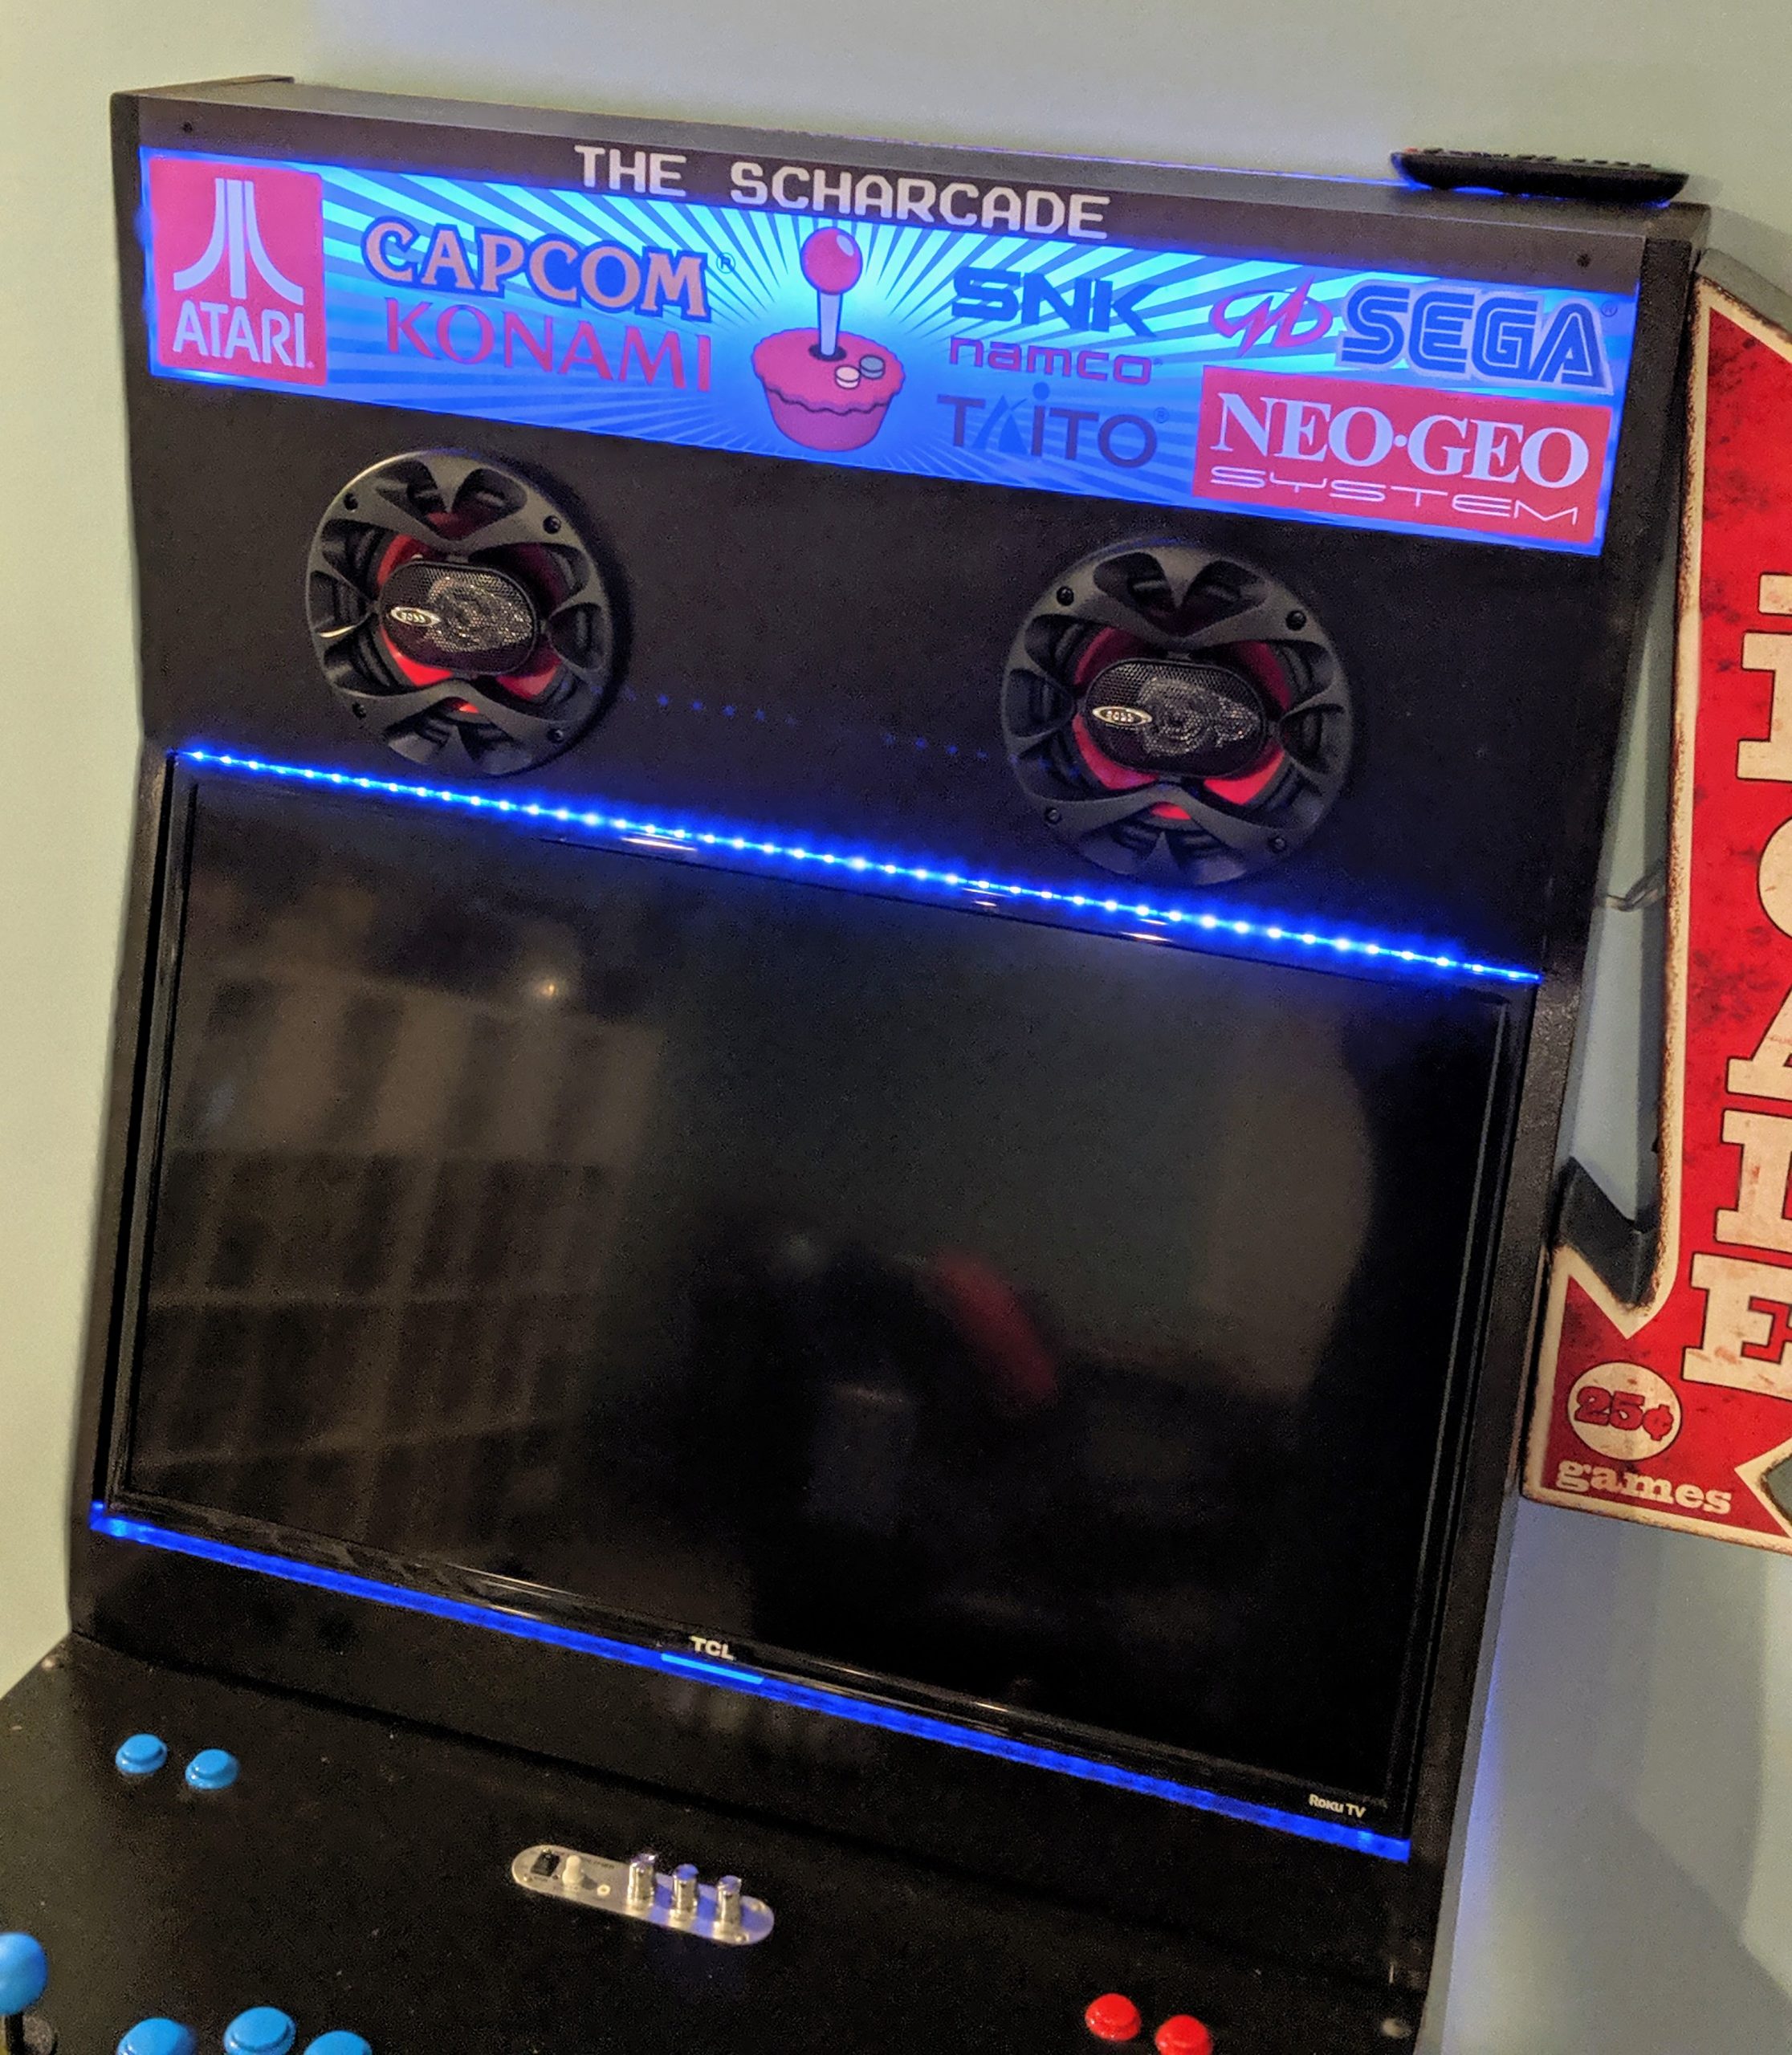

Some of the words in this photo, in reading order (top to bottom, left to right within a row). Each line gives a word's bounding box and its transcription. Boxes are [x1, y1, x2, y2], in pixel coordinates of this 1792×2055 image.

[574, 144, 687, 198] THE
[730, 161, 1111, 240] SCHARCADE
[361, 216, 712, 321] CAPCOM
[951, 266, 1161, 338] SNK
[173, 300, 307, 368] ATARI
[385, 297, 713, 393] KONAMI
[949, 337, 1153, 385] namco
[1339, 281, 1614, 394] SEGA
[1210, 466, 1579, 526] SYSTEM
[1555, 1459, 1733, 1516] games
[689, 1635, 734, 1661] TCL
[1346, 1803, 1366, 1818] TV
